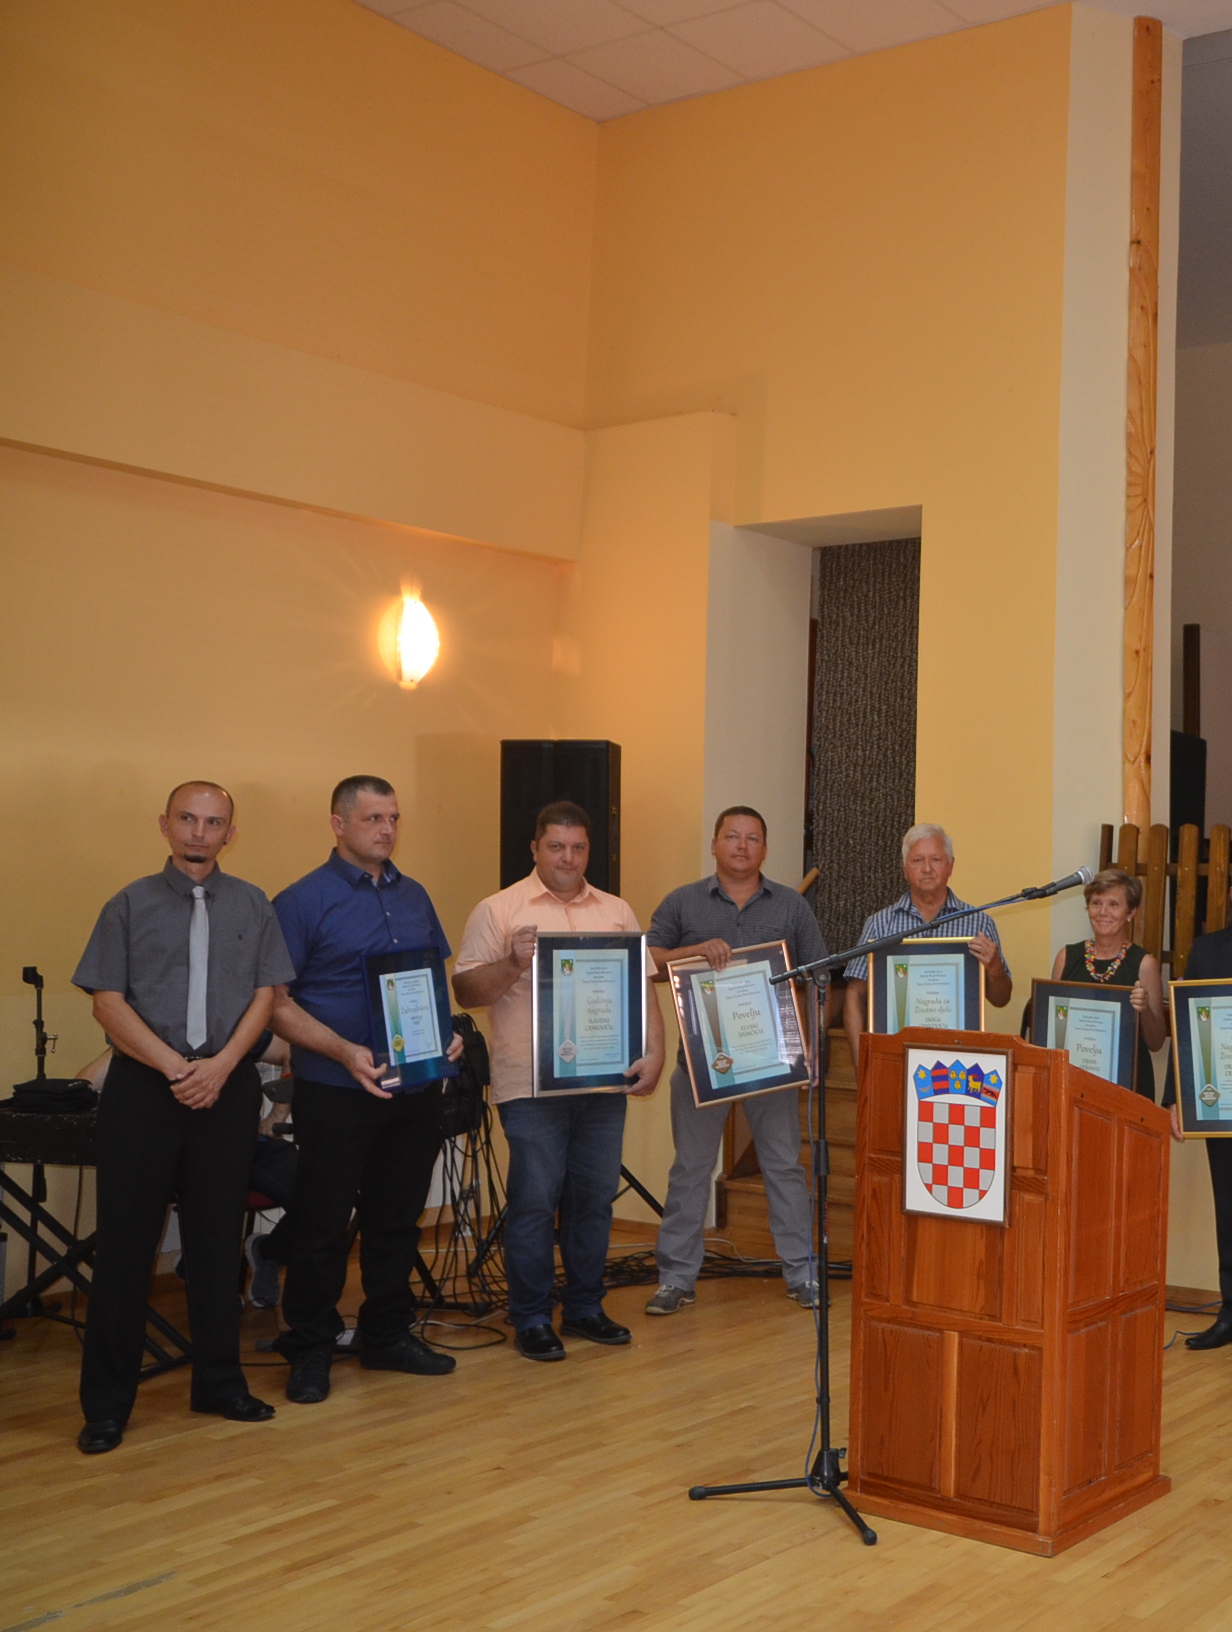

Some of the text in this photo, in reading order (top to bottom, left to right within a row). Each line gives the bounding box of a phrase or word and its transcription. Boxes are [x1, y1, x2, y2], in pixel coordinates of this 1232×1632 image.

[915, 997, 942, 1006] Nagradu
[732, 1007, 761, 1020] Povelju
[938, 1005, 951, 1015] djelo
[1076, 1043, 1102, 1057] Povelju
